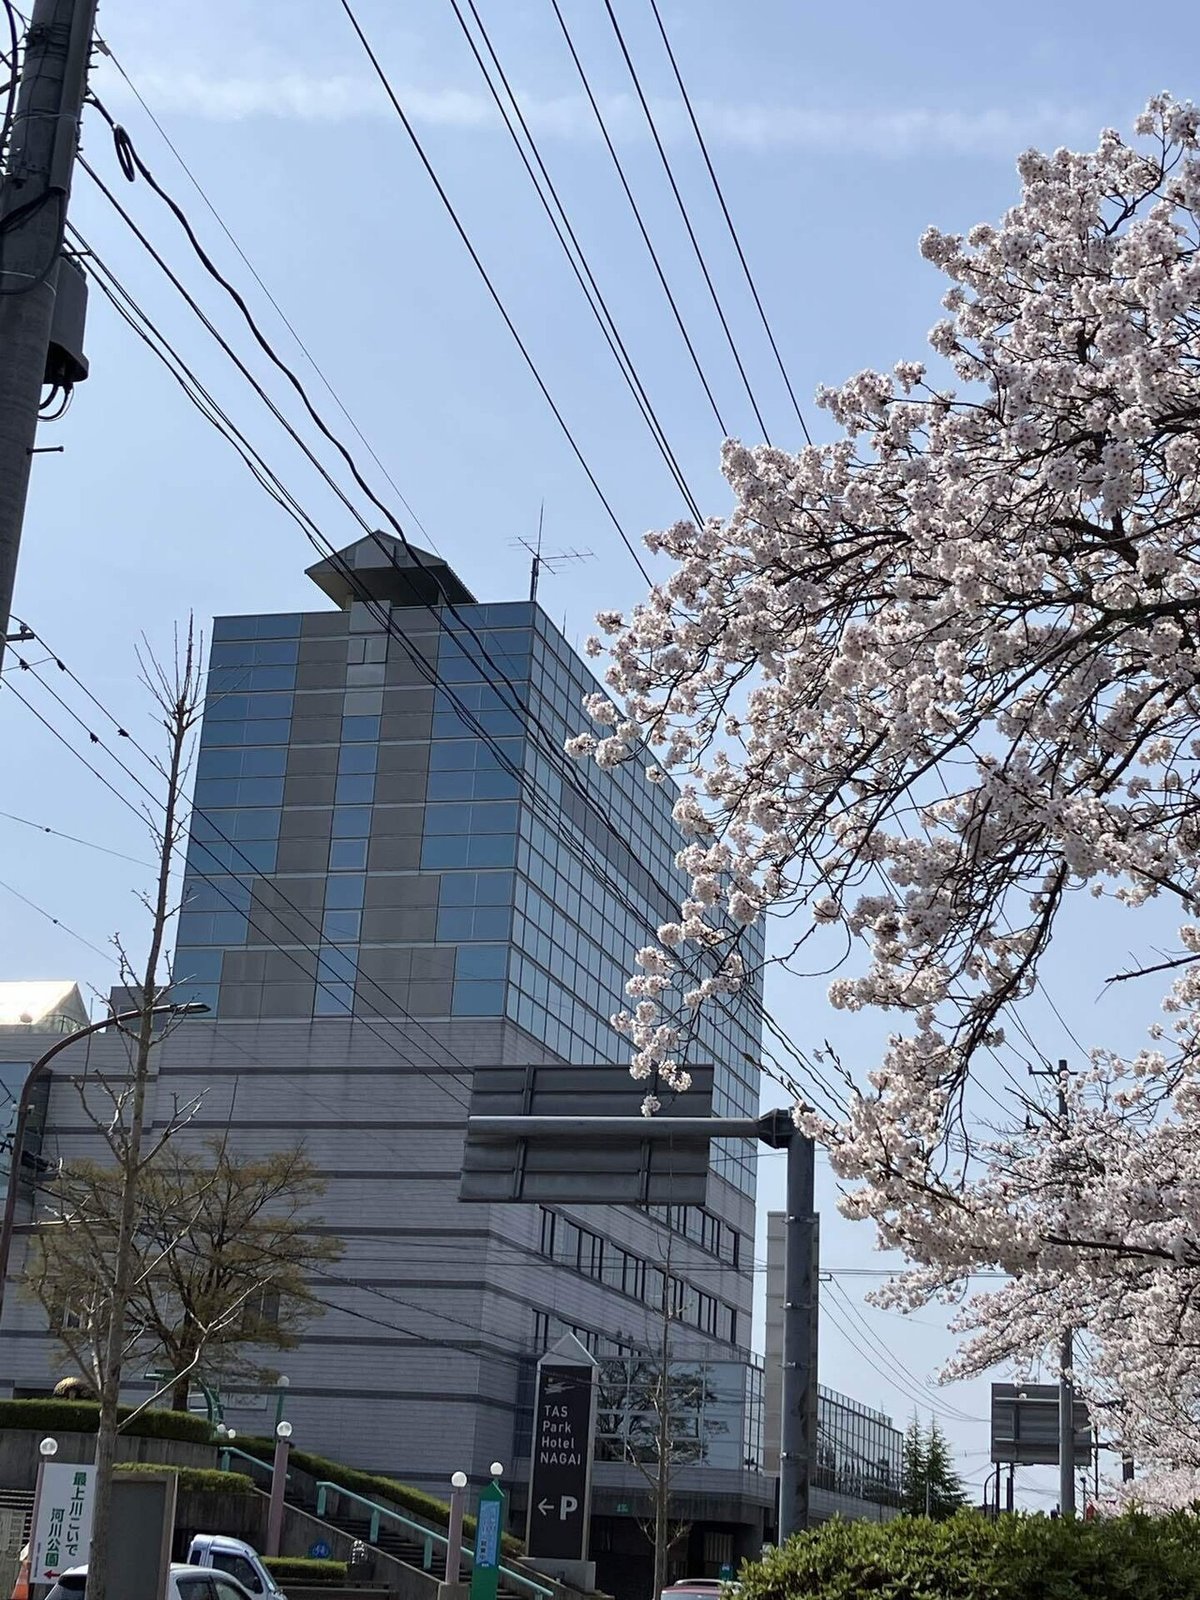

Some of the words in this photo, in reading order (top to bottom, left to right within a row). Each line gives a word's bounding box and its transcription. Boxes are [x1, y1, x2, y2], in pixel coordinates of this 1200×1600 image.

[544, 1405, 568, 1417] TAS
[542, 1420, 571, 1433] Park
[541, 1436, 574, 1449] Hotel
[540, 1452, 581, 1465] NAGAI
[65, 1472, 87, 1556] 最上川こいで
[560, 1495, 578, 1520] P
[45, 1507, 65, 1567] 河川公園
